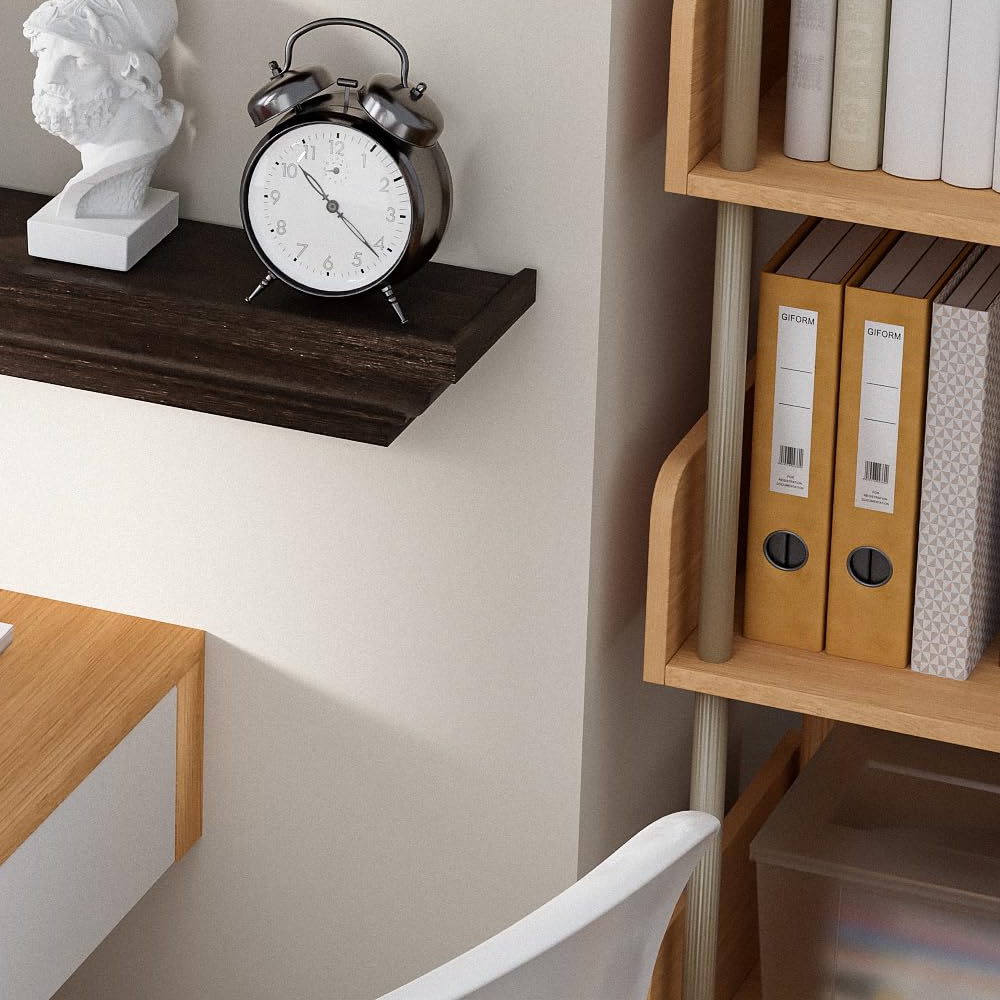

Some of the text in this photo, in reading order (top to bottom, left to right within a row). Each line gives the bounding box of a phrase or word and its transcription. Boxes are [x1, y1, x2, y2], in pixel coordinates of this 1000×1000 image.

[303, 145, 316, 160] 11
[328, 140, 345, 156] 12
[361, 153, 367, 168] 1
[281, 162, 298, 178] 10
[379, 177, 390, 192] 2
[270, 189, 281, 205] 9
[385, 207, 396, 222] 3
[276, 219, 287, 235] 8
[296, 242, 309, 258] 7
[373, 236, 385, 250] 4
[323, 255, 334, 271] 6
[351, 252, 363, 267] 5
[781, 312, 815, 325] GIFORM
[867, 327, 901, 340] GIFORM
